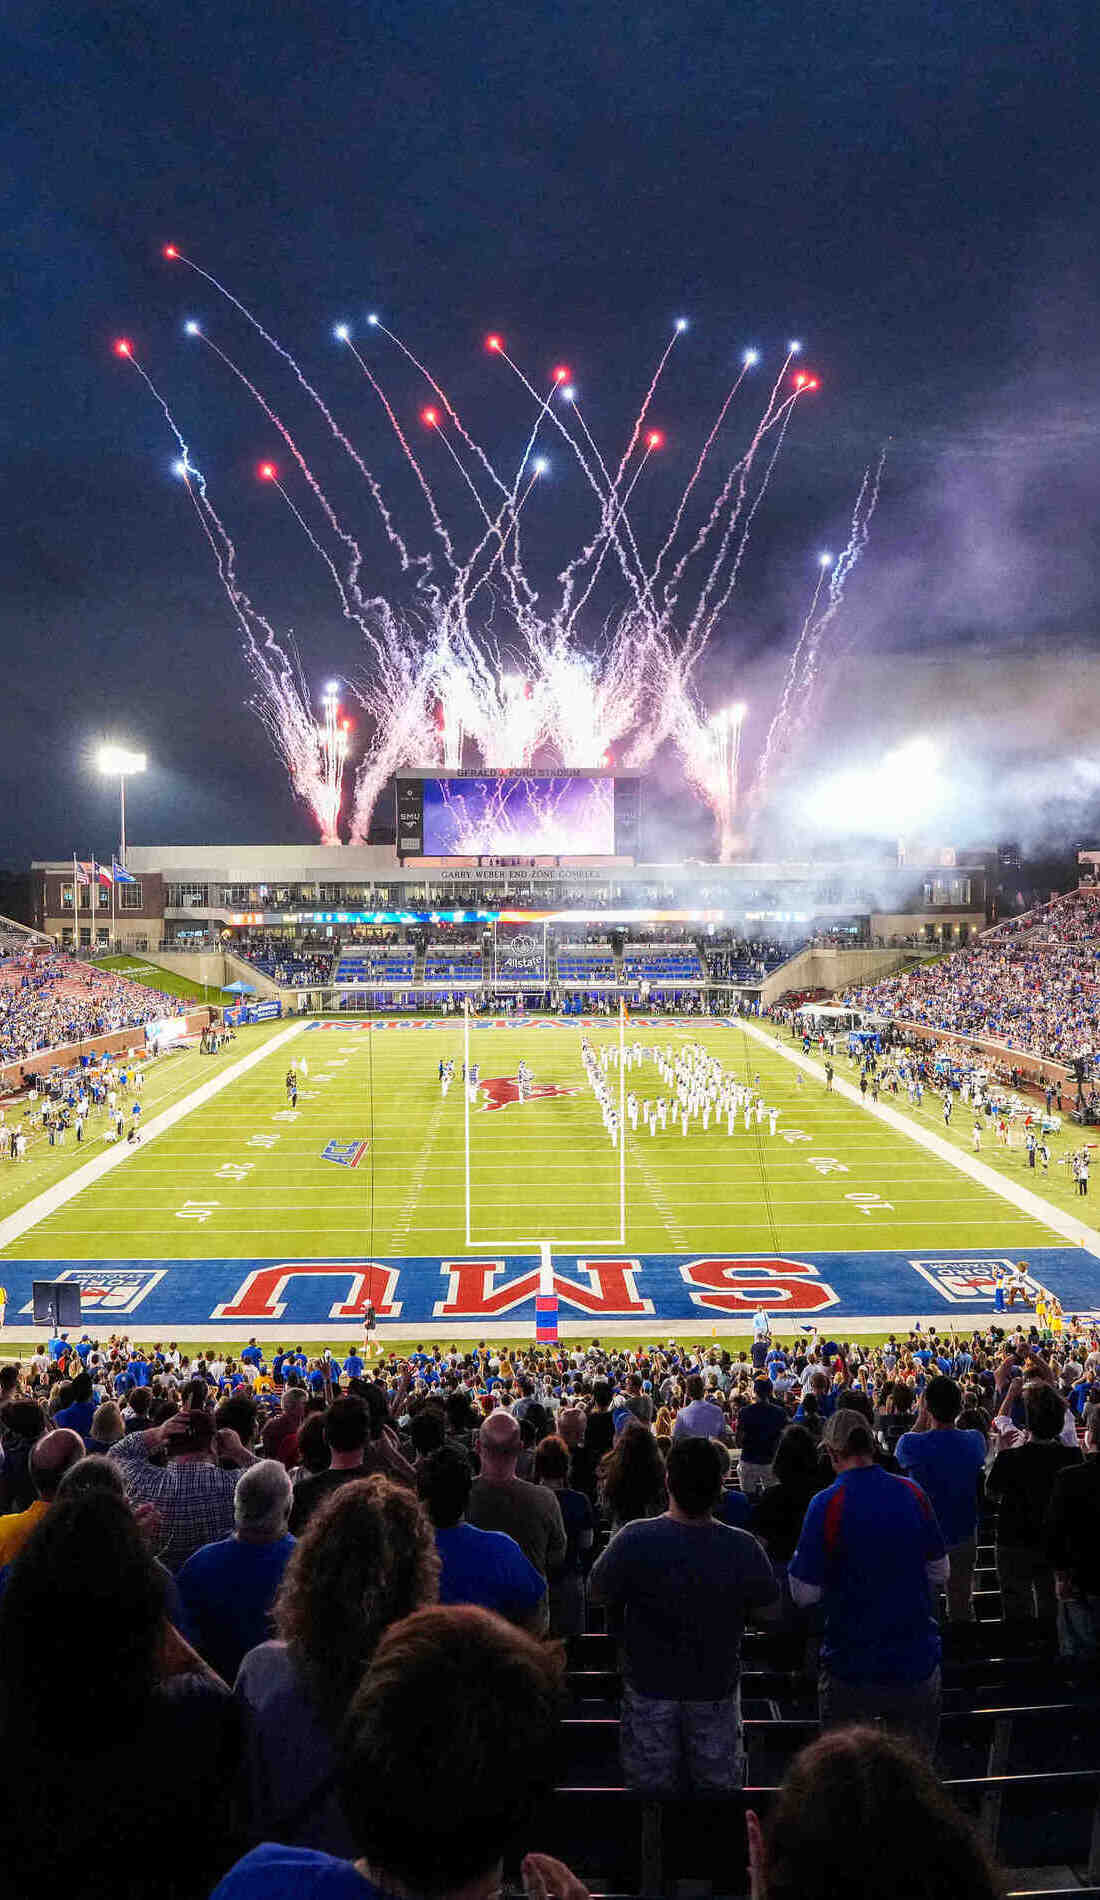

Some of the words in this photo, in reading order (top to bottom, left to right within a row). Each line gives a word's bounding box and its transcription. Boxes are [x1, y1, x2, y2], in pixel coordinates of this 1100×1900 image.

[457, 768, 496, 777] GERALD
[509, 768, 536, 777] FORD
[537, 768, 581, 777] STADIUM
[400, 813, 420, 821] SMU
[441, 871, 472, 880] GARRY
[475, 871, 504, 880] WEBER
[509, 871, 528, 880] END
[531, 871, 554, 880] ZONE
[504, 955, 544, 969] Allstate
[303, 1018, 737, 1031] MUSTANGS
[844, 1192, 895, 1211] 10
[175, 1200, 221, 1218] 10
[209, 1257, 842, 1319] SMU
